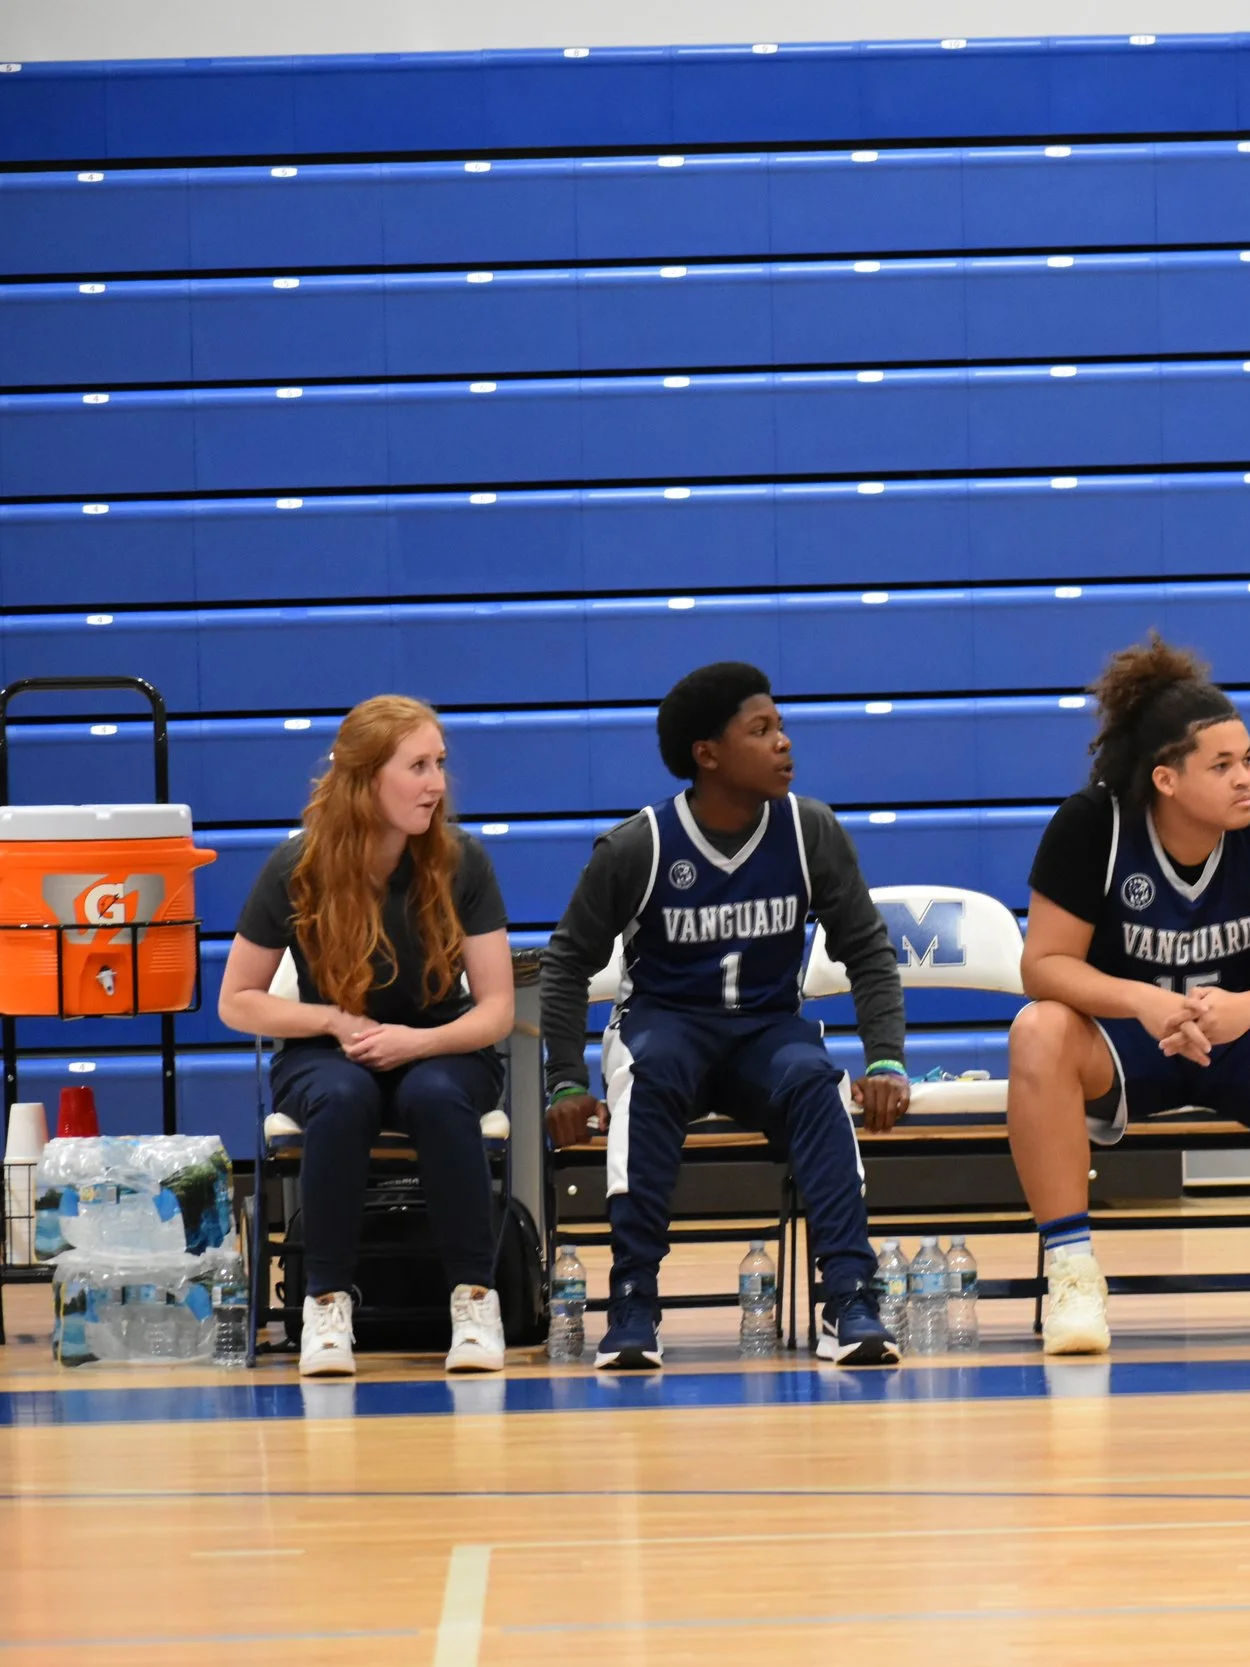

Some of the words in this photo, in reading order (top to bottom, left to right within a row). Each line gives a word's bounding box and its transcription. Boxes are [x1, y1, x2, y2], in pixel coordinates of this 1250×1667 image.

[84, 883, 125, 925] G
[662, 895, 798, 943] VANGUARD
[872, 899, 966, 967] M
[720, 951, 743, 1009] 1
